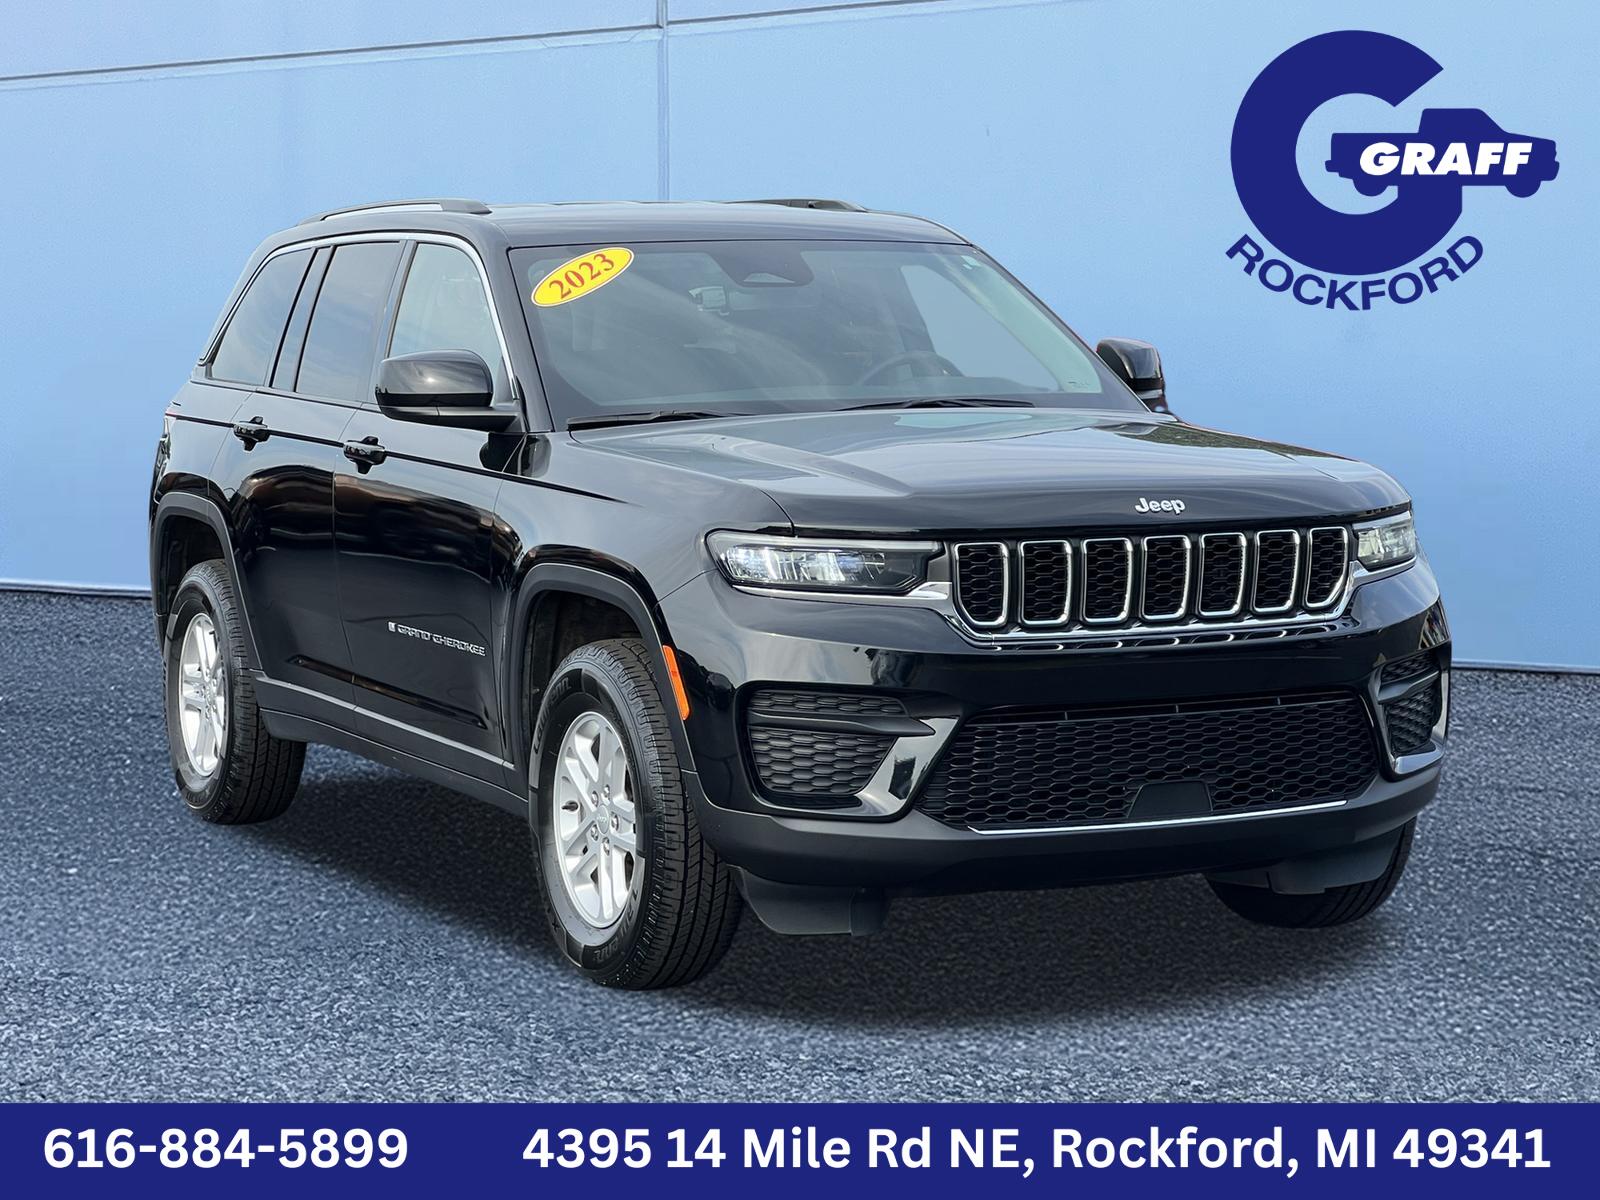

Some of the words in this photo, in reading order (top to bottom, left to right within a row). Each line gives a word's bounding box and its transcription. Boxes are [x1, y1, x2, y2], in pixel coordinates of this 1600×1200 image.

[549, 253, 615, 299] 2023
[1134, 497, 1186, 515] Jeep
[397, 623, 432, 641] GRAND
[432, 633, 486, 657] CHEROKEE
